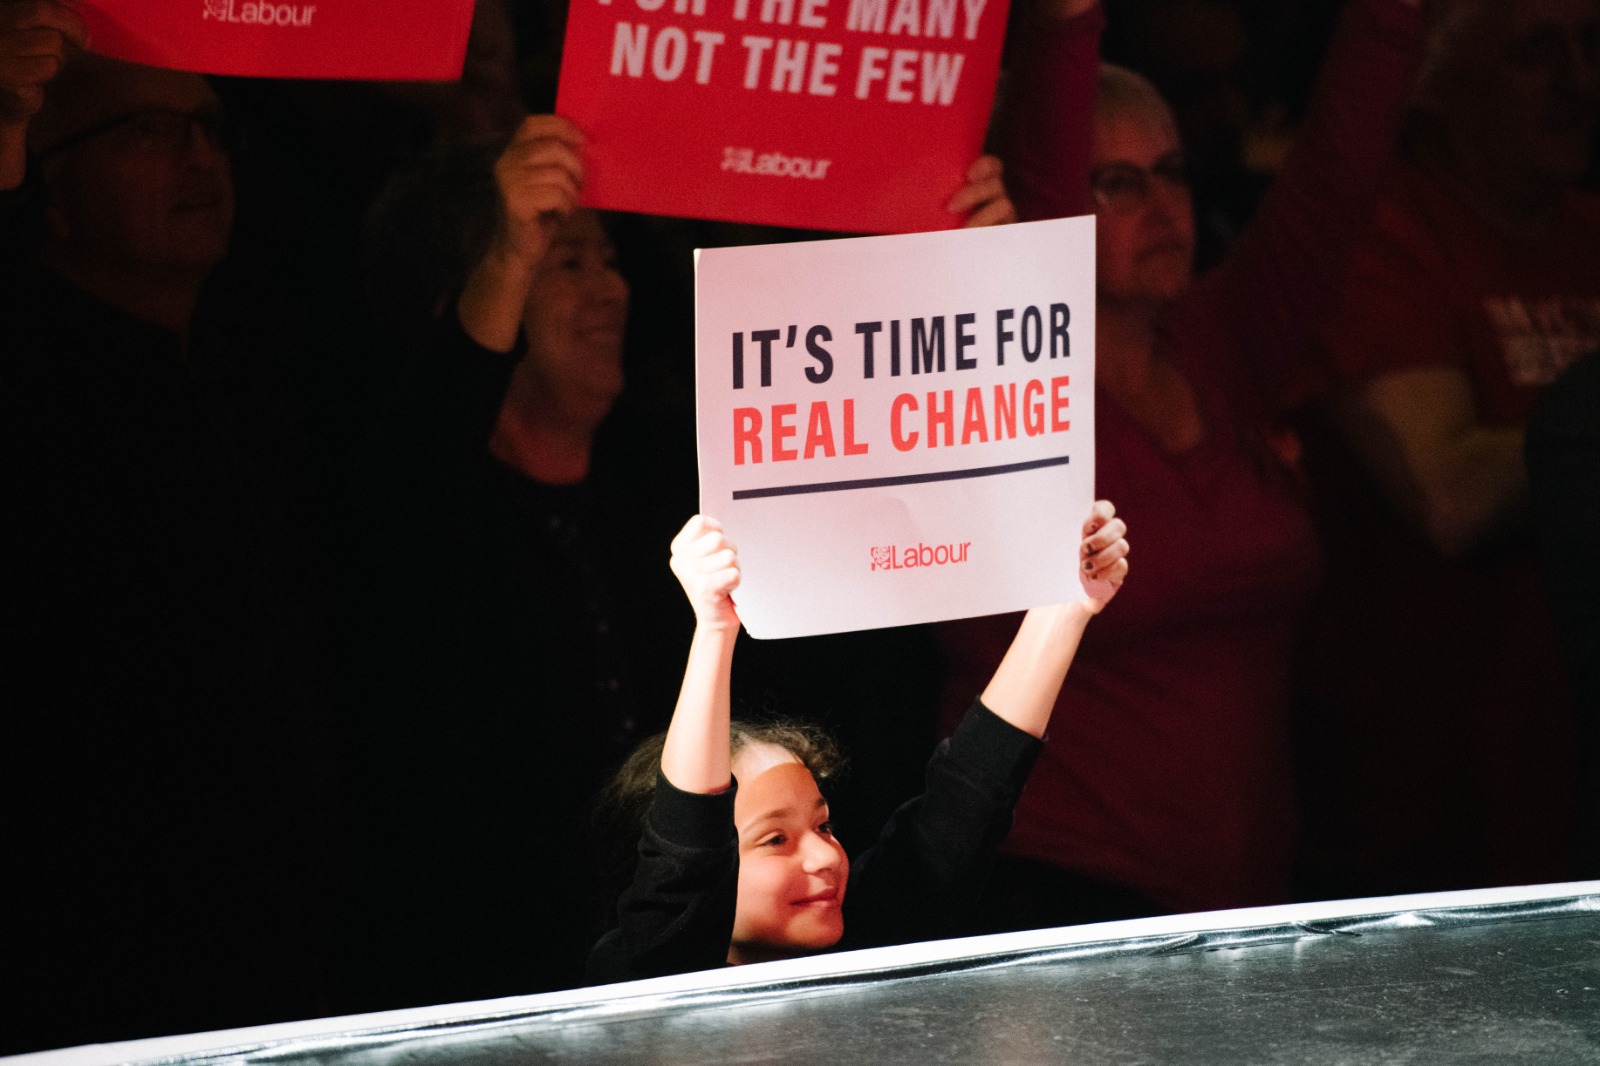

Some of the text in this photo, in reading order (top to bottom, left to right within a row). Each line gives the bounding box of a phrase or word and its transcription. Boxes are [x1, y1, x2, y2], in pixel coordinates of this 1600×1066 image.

[228, 0, 317, 27] Labour
[847, 0, 988, 41] MANY
[610, 21, 965, 105] NOT THE FEW
[744, 148, 832, 180] Labour
[732, 302, 1071, 389] IT'S TIME FOR
[733, 375, 1071, 466] REAL CHANGE
[892, 542, 971, 570] Labour
